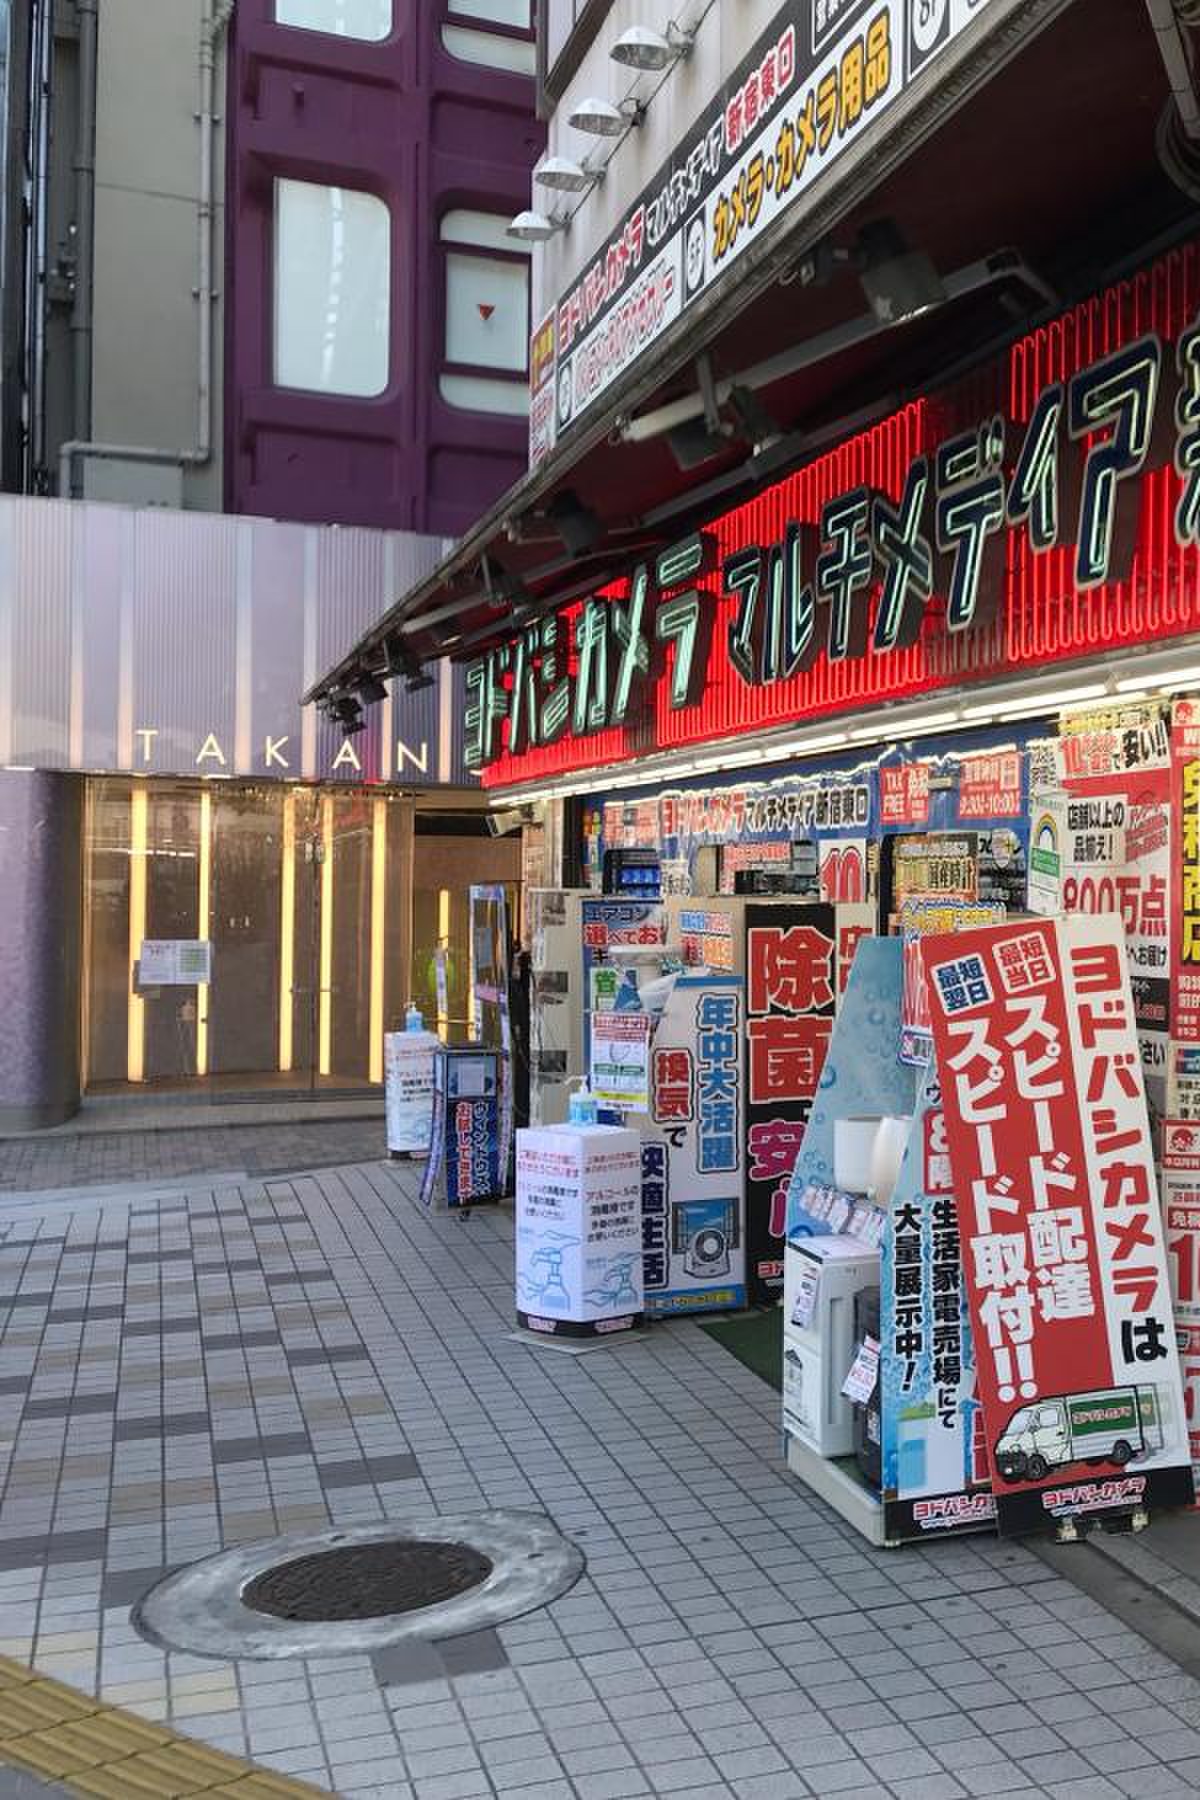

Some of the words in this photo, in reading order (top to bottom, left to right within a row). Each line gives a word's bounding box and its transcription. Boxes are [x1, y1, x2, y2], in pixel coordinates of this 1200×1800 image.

[711, 12, 892, 262] カメラ・カメラ用品
[465, 538, 703, 772] ヨドバシカメラ
[1067, 803, 1124, 830] 店舗以上の
[699, 994, 737, 1171] 年中大活躍
[748, 926, 835, 1105] 除菌
[945, 1017, 1040, 1402] スピード取付!!
[1003, 993, 1096, 1324] スピード配達
[1070, 944, 1169, 1365] ヨドバシカメラは
[894, 1202, 925, 1391] 大量展示中!
[931, 1199, 961, 1430] 生活家電売場にて
[1041, 1476, 1147, 1510] ヨドバシカメラ
